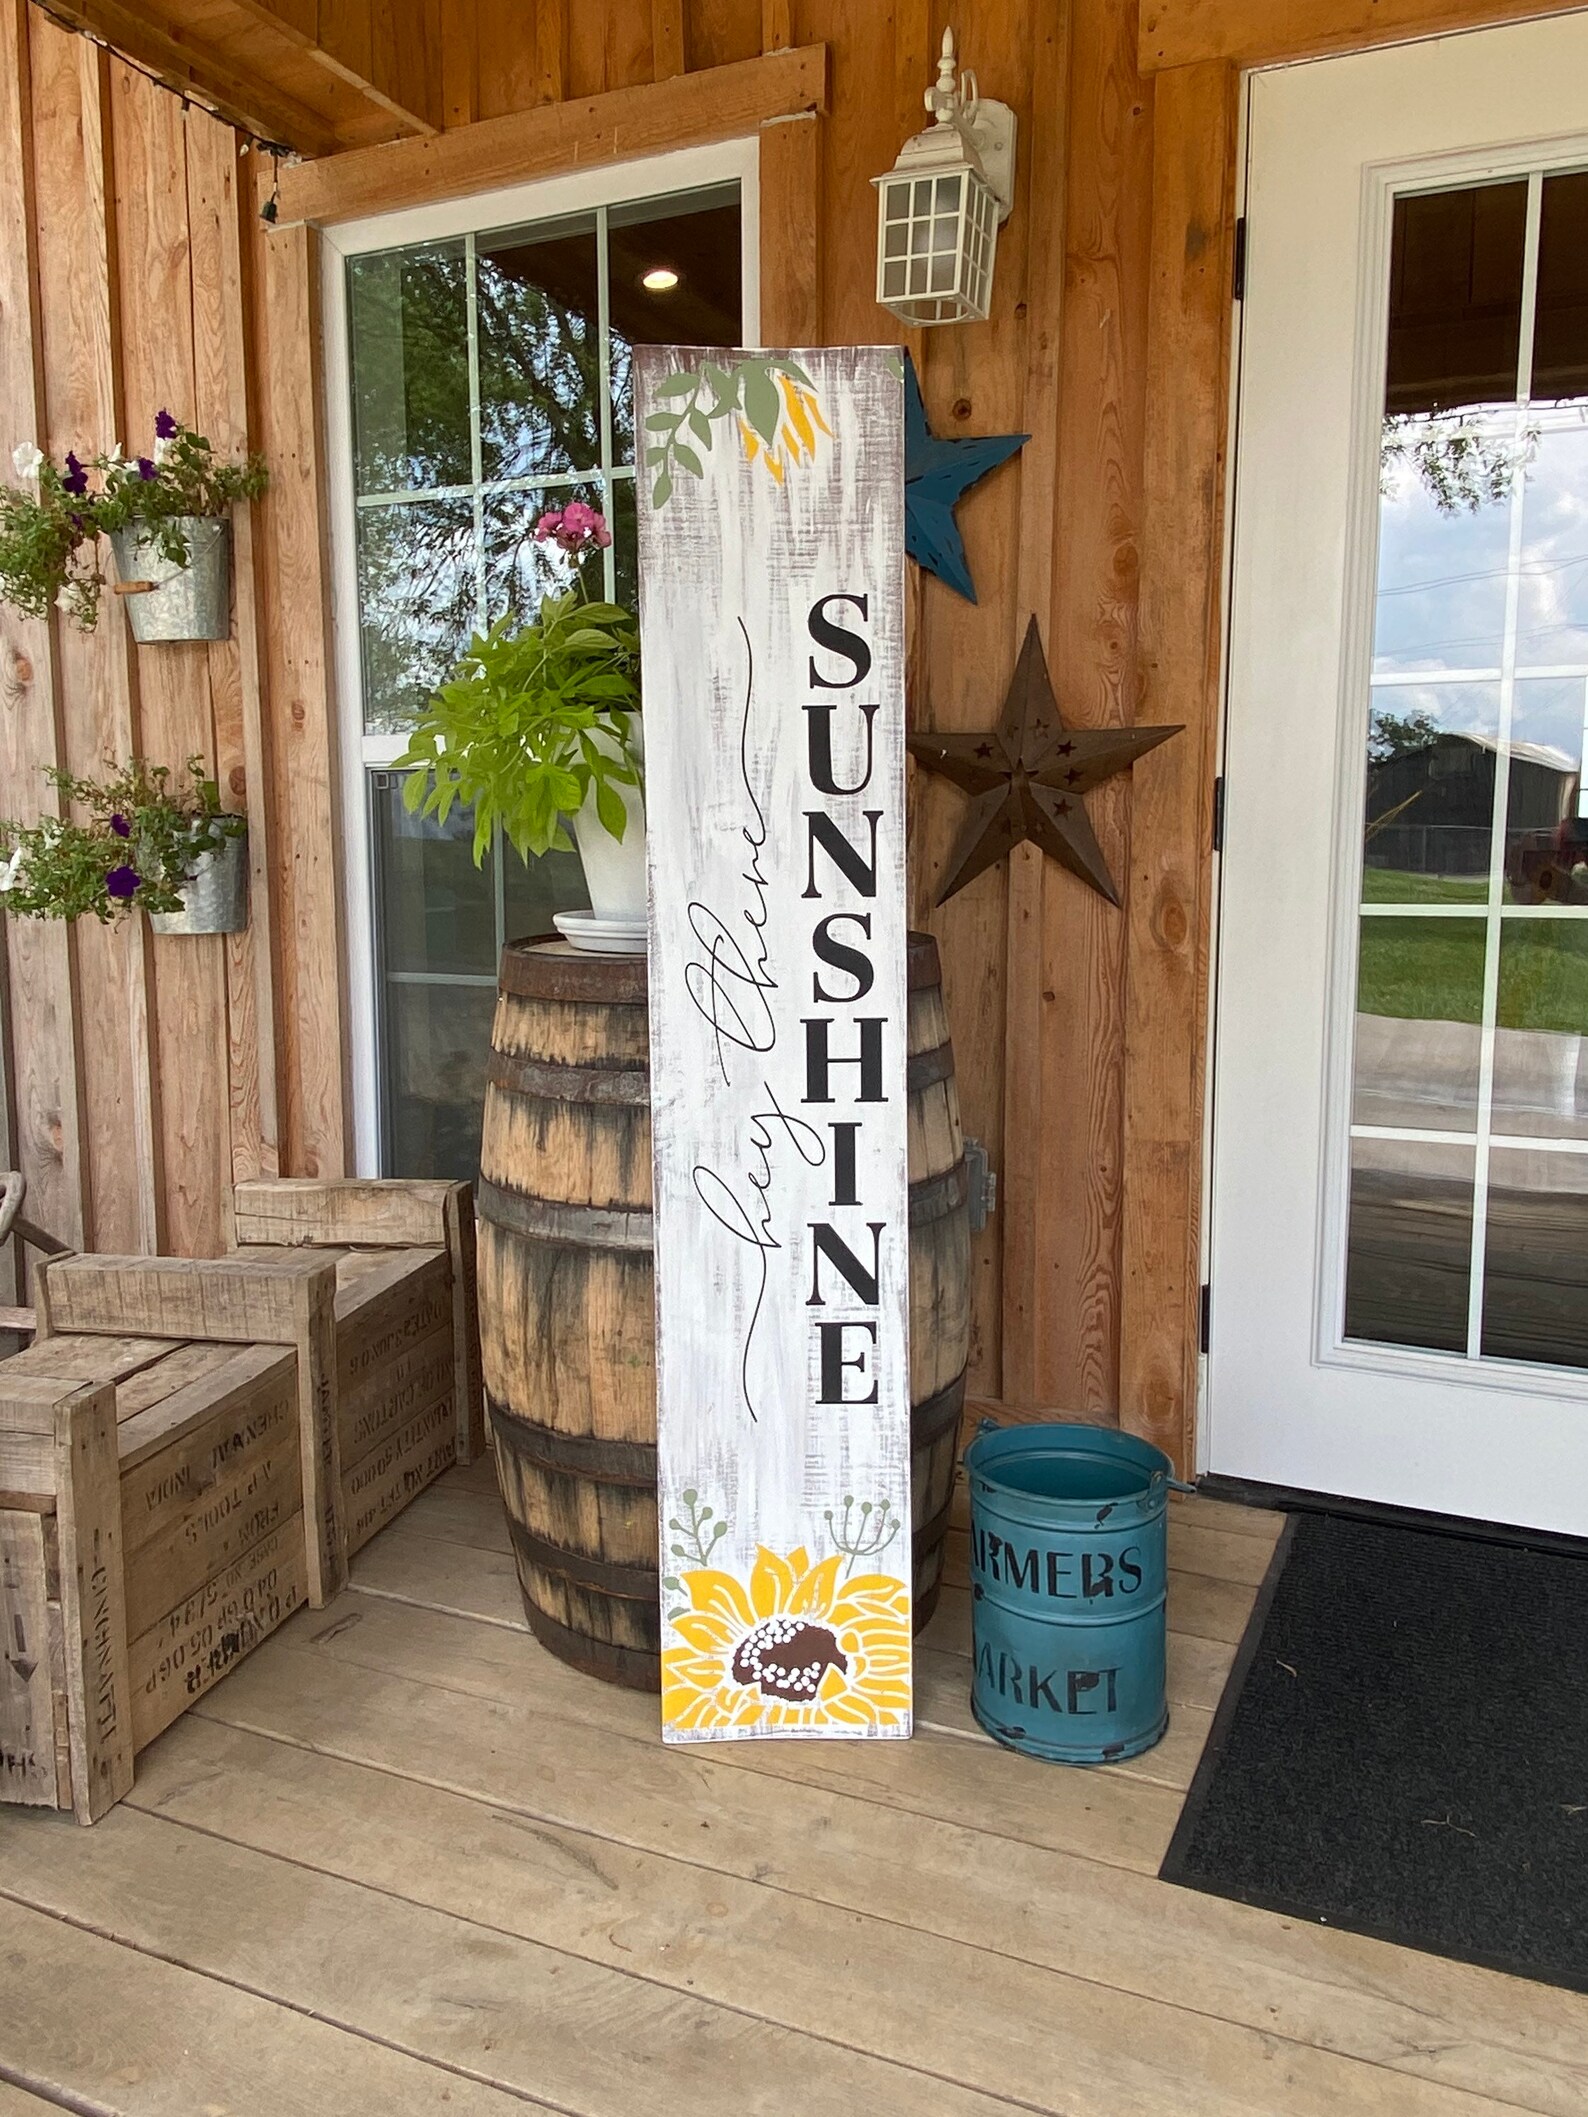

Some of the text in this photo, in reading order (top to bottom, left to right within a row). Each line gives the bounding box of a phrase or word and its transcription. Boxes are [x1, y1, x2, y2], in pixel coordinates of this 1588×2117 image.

[685, 616, 825, 1422] hey there
[800, 593, 888, 1404] SUNSHINE
